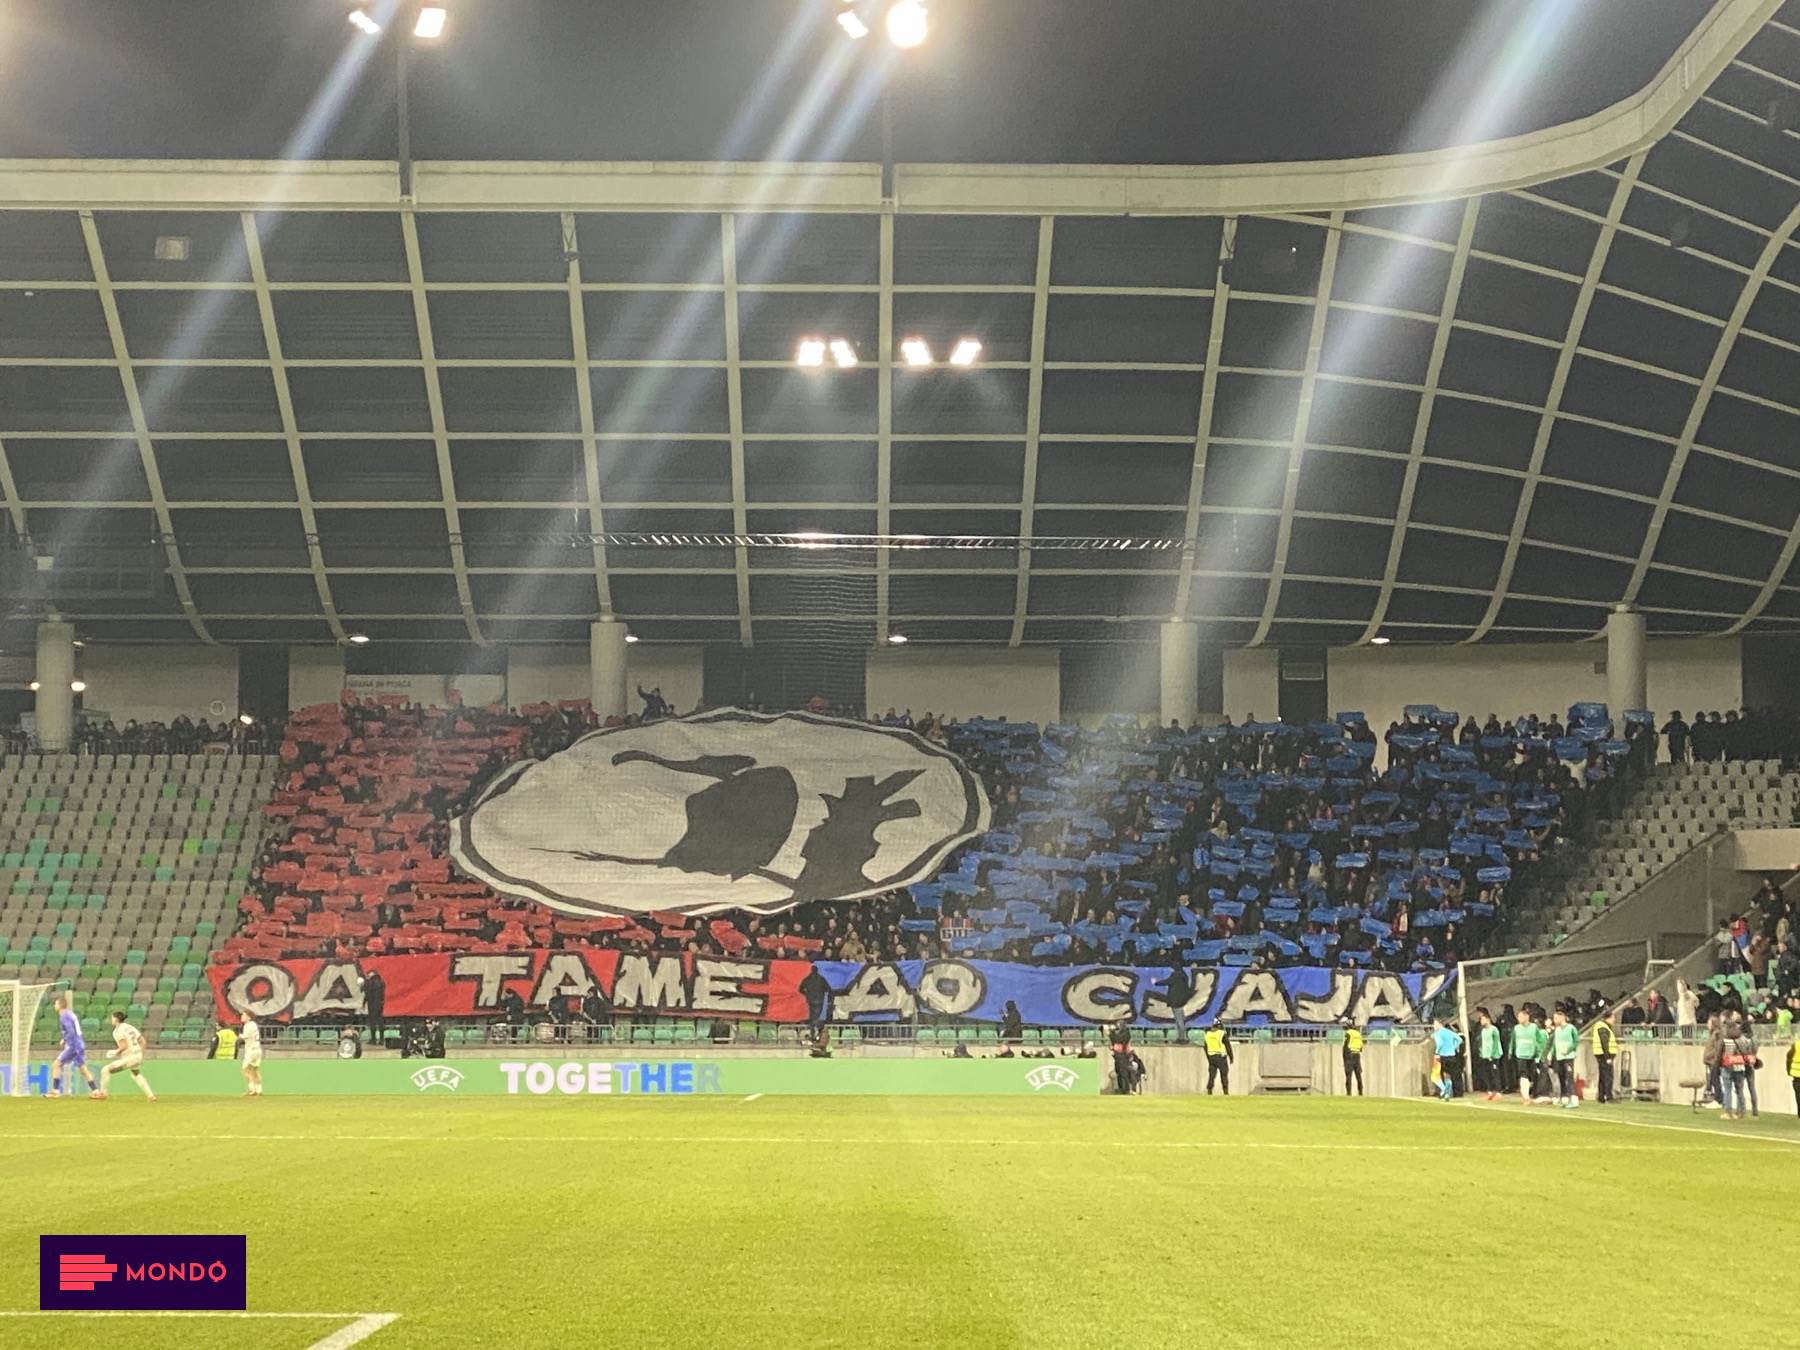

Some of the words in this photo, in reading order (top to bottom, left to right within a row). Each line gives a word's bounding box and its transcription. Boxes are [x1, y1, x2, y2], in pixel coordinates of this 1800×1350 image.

[453, 954, 766, 1013] ТАМЕ
[832, 963, 984, 1021] ДО
[410, 1068, 461, 1089] UEFA
[500, 1062, 722, 1094] TOGETHER
[1028, 1068, 1076, 1088] UEFA
